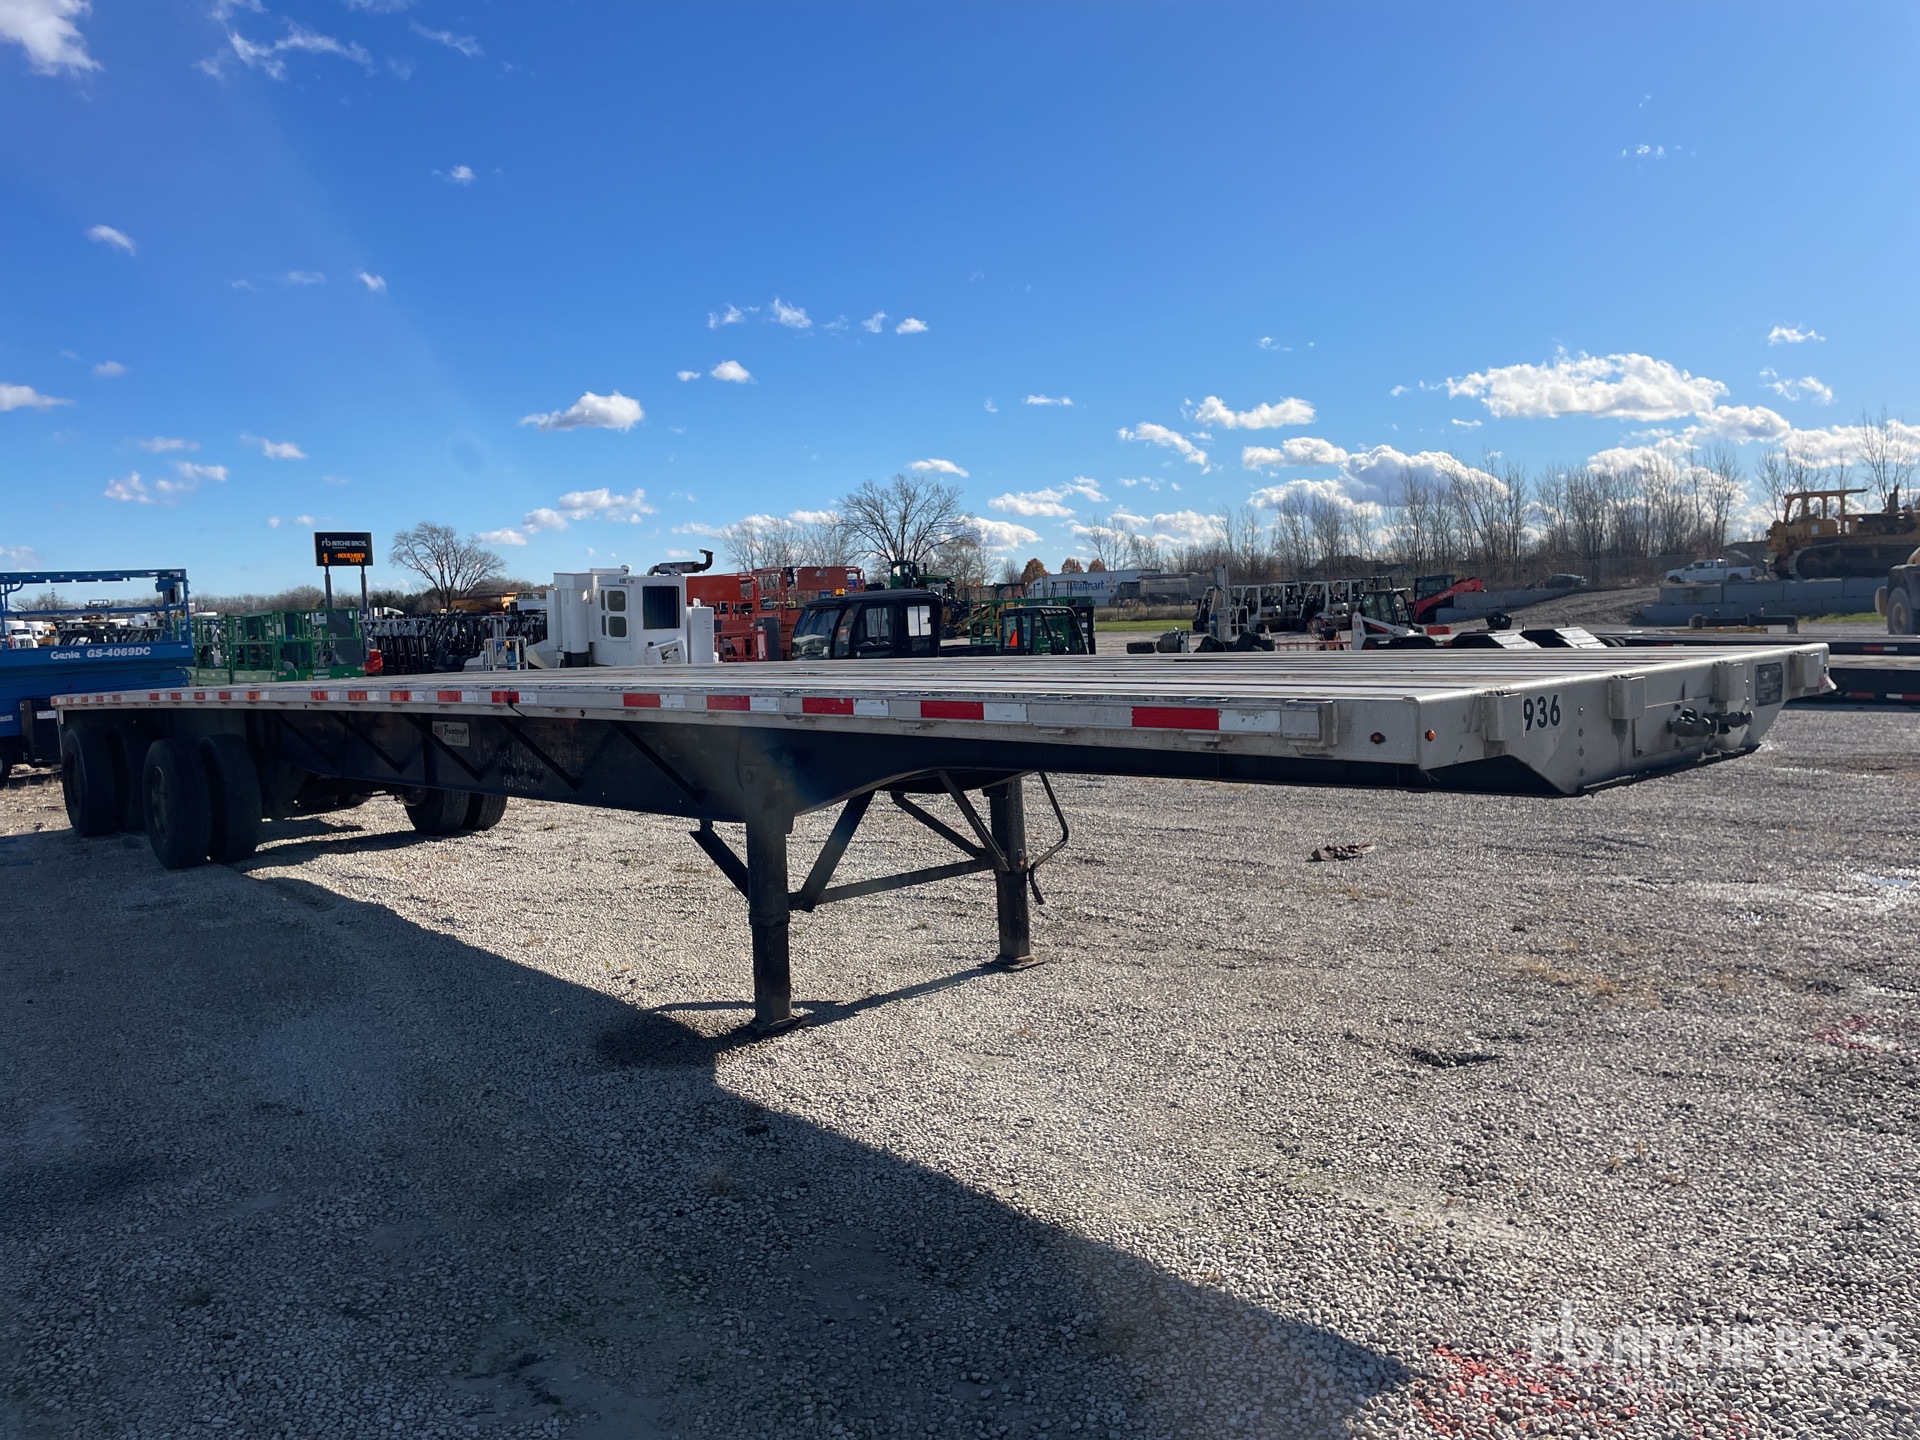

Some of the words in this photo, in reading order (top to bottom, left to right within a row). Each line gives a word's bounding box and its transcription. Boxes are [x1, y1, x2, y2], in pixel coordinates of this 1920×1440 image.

[1071, 580, 1105, 591] Walmart
[50, 651, 81, 660] Genie
[86, 647, 151, 658] GS-4069DC
[1523, 694, 1561, 731] 936
